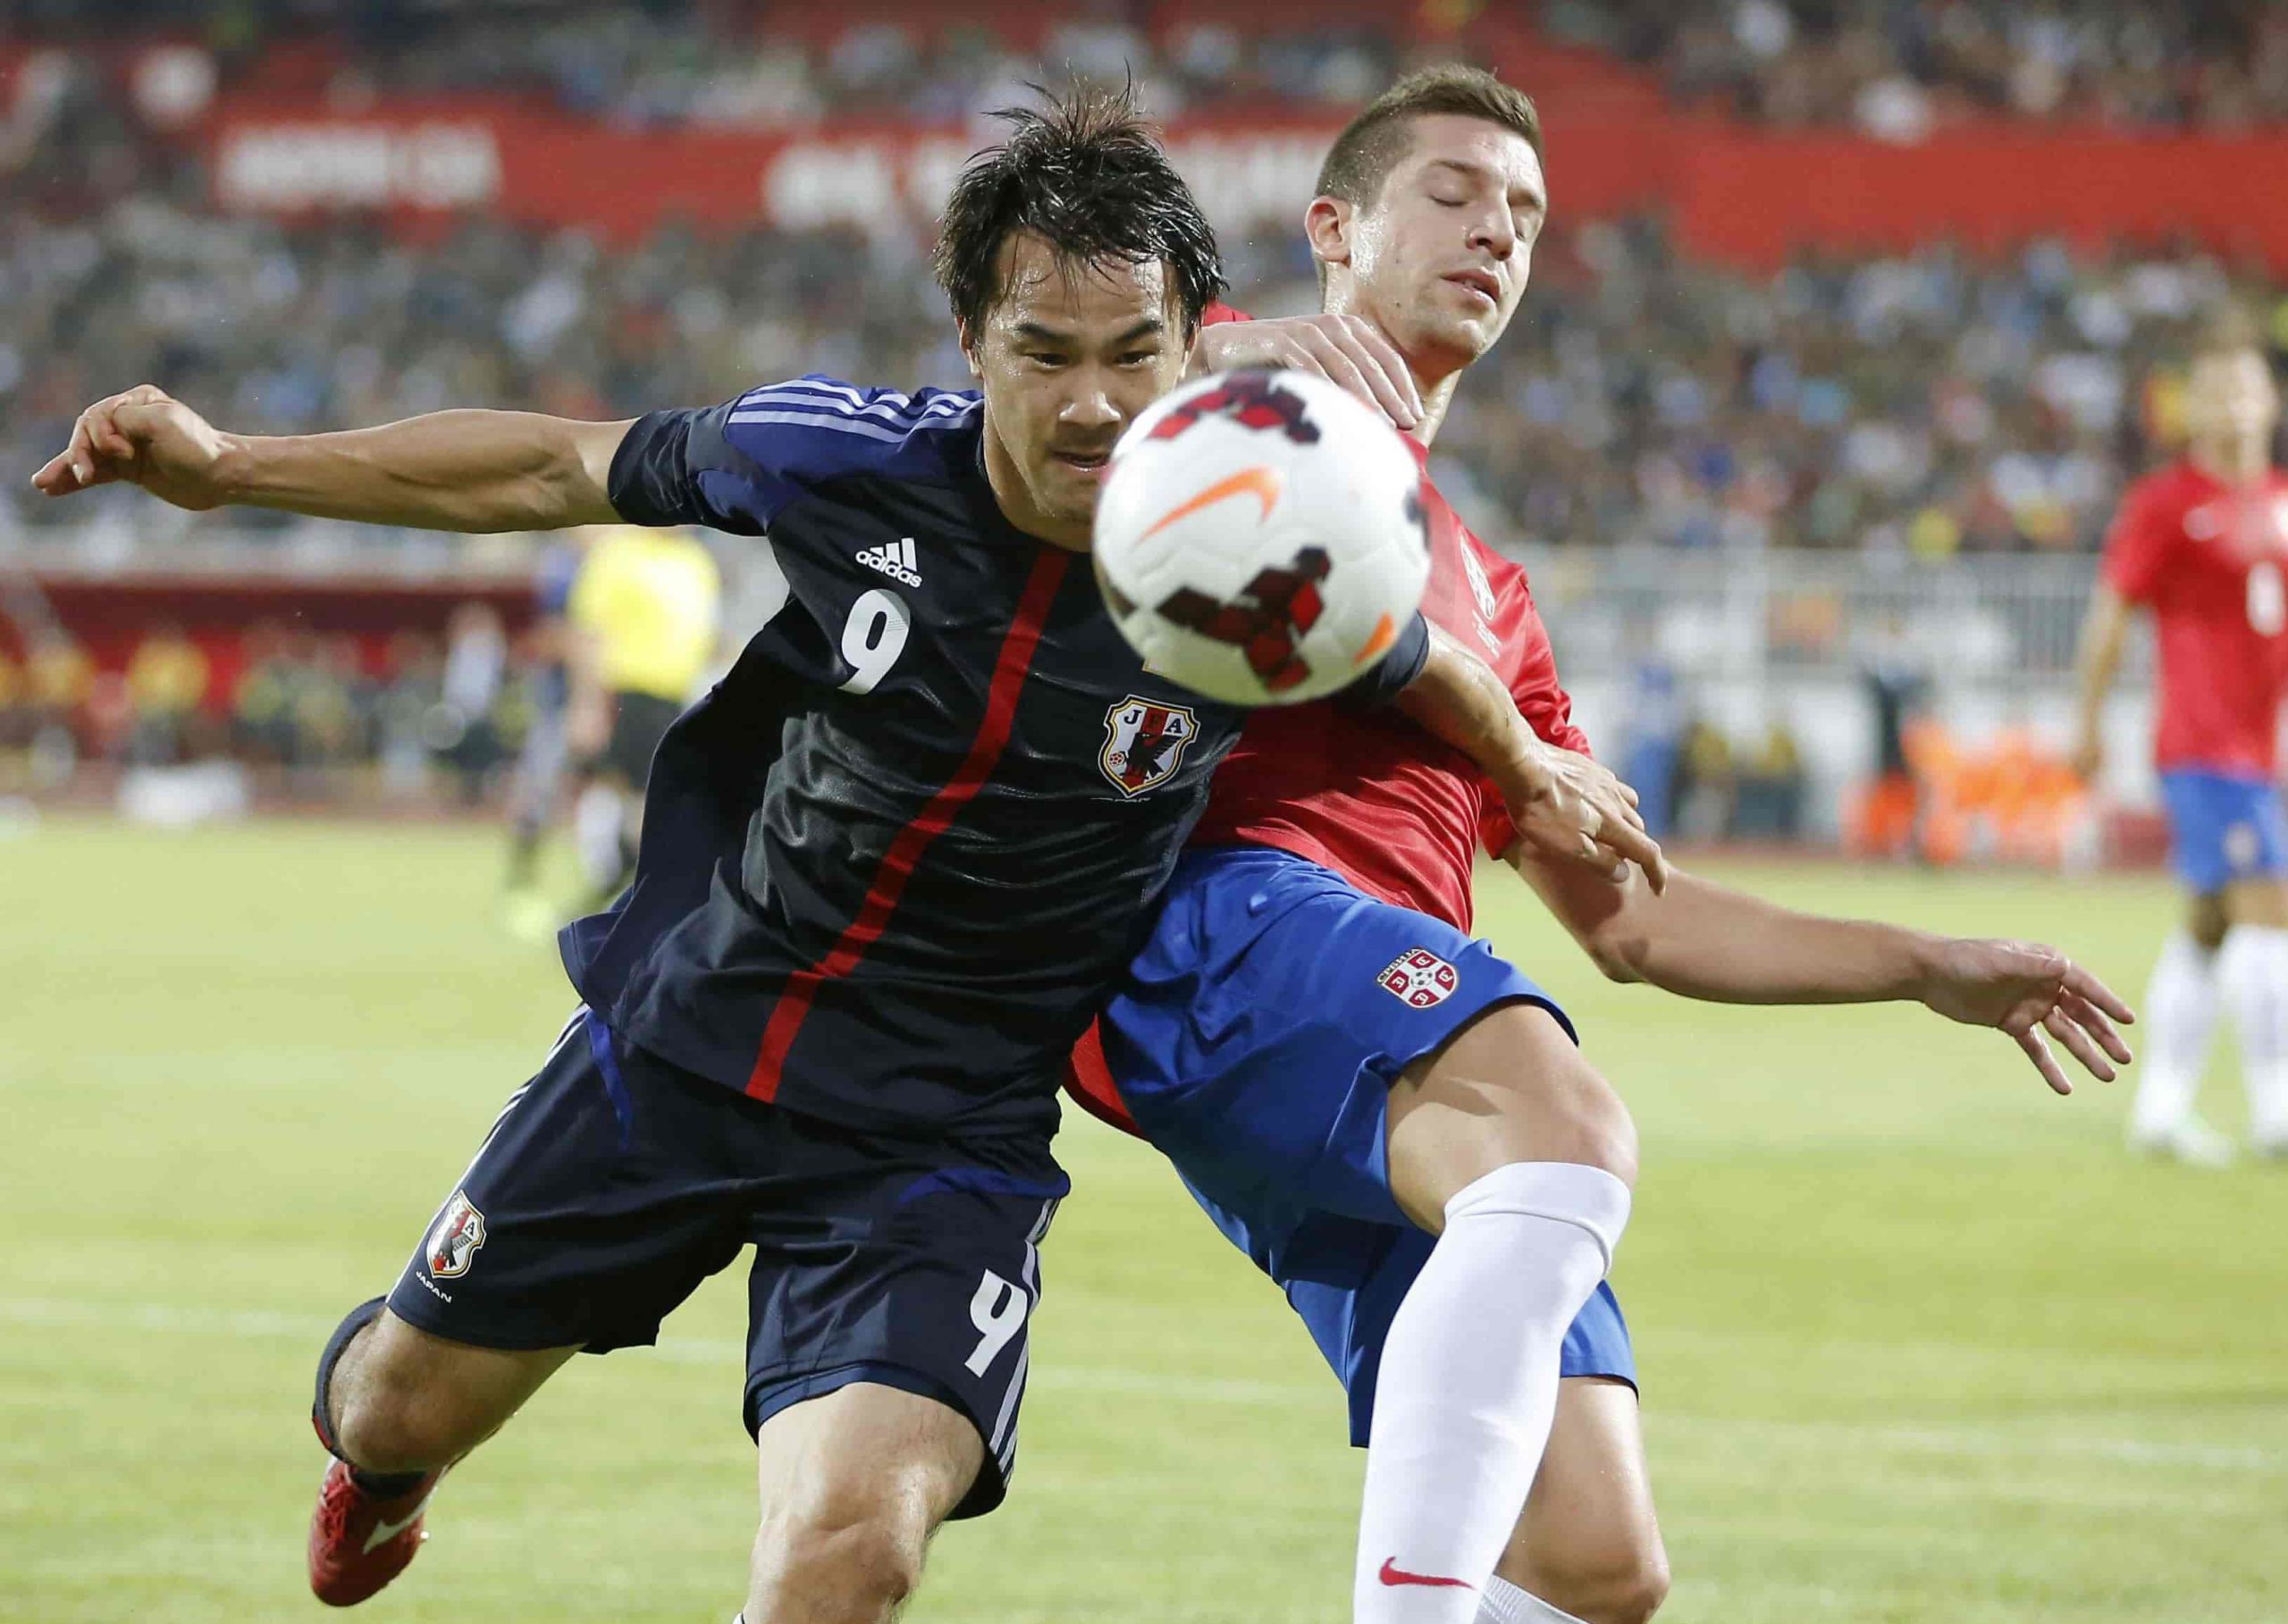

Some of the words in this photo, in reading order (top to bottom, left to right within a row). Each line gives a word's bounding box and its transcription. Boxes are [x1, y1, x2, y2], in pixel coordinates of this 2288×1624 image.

[855, 551, 922, 588] adidas
[838, 588, 910, 694] 9
[416, 1271, 452, 1303] JAPAN
[964, 1268, 1028, 1378] 9
